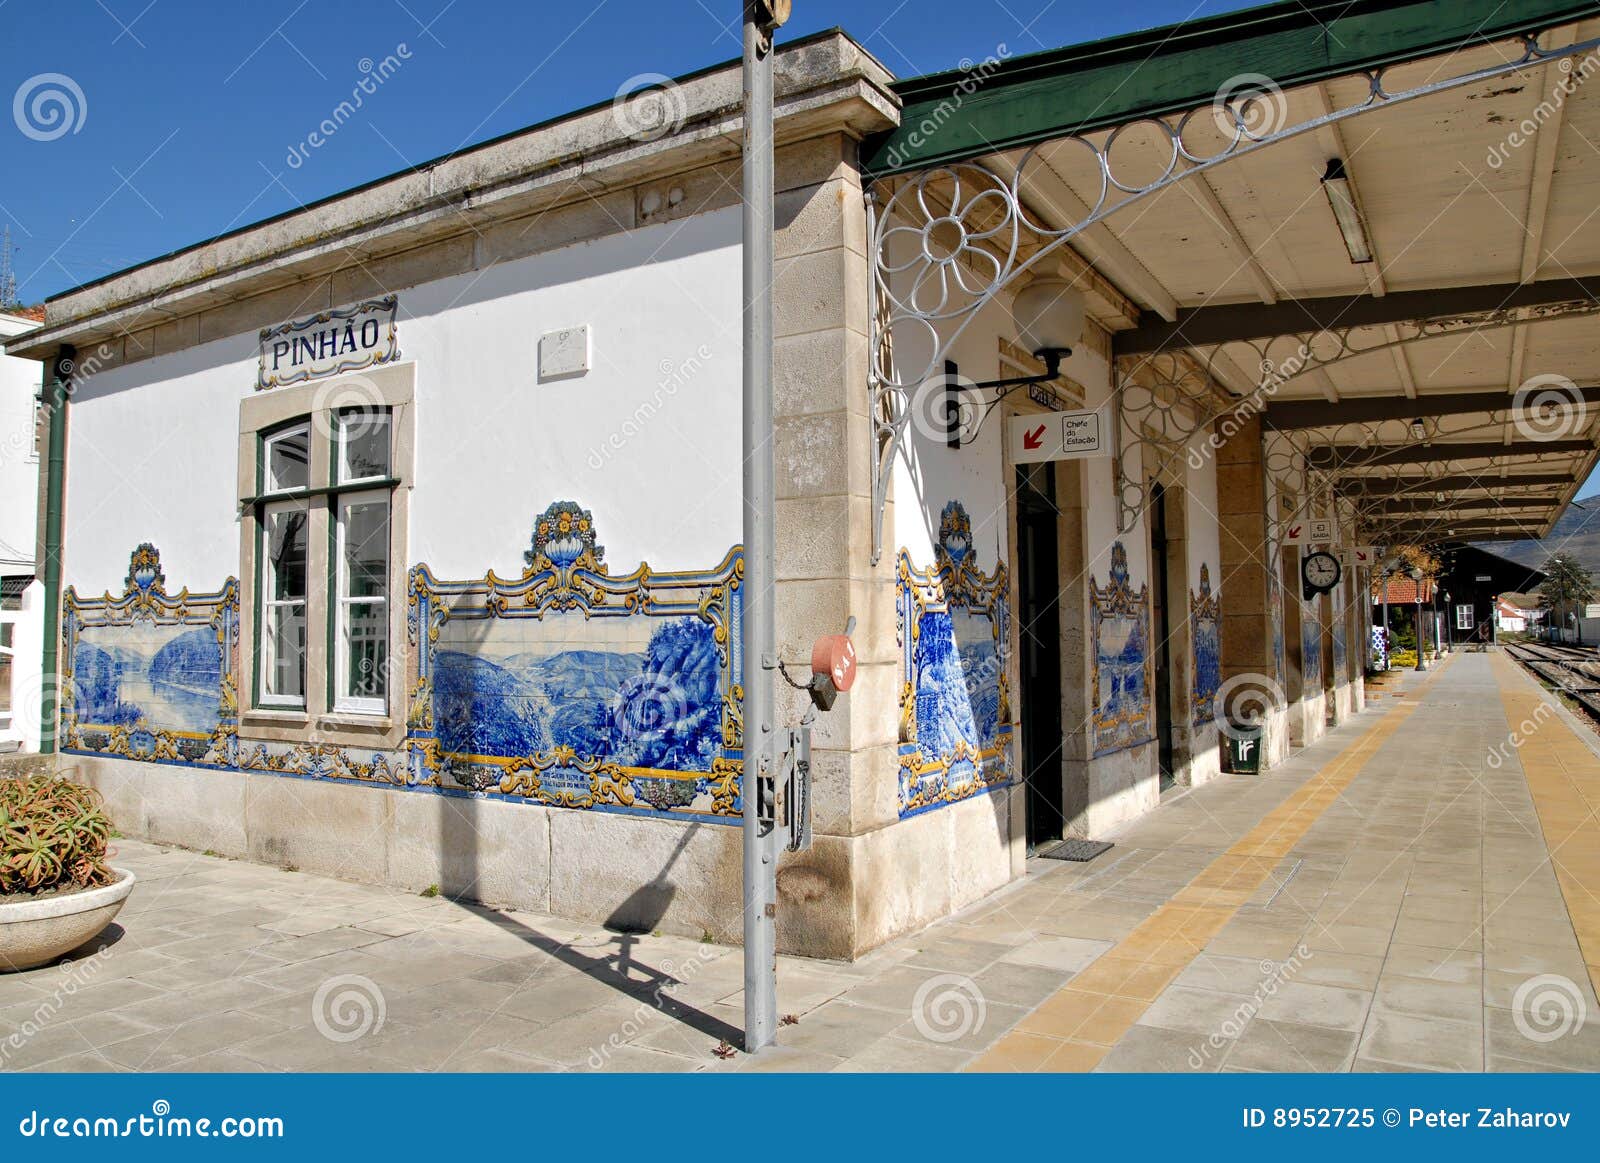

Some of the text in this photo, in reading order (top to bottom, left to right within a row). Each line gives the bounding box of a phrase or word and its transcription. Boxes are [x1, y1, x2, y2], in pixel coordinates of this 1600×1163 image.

[272, 318, 379, 371] PINHÃO
[1066, 420, 1088, 428] Chefe
[1066, 437, 1096, 445] Estação
